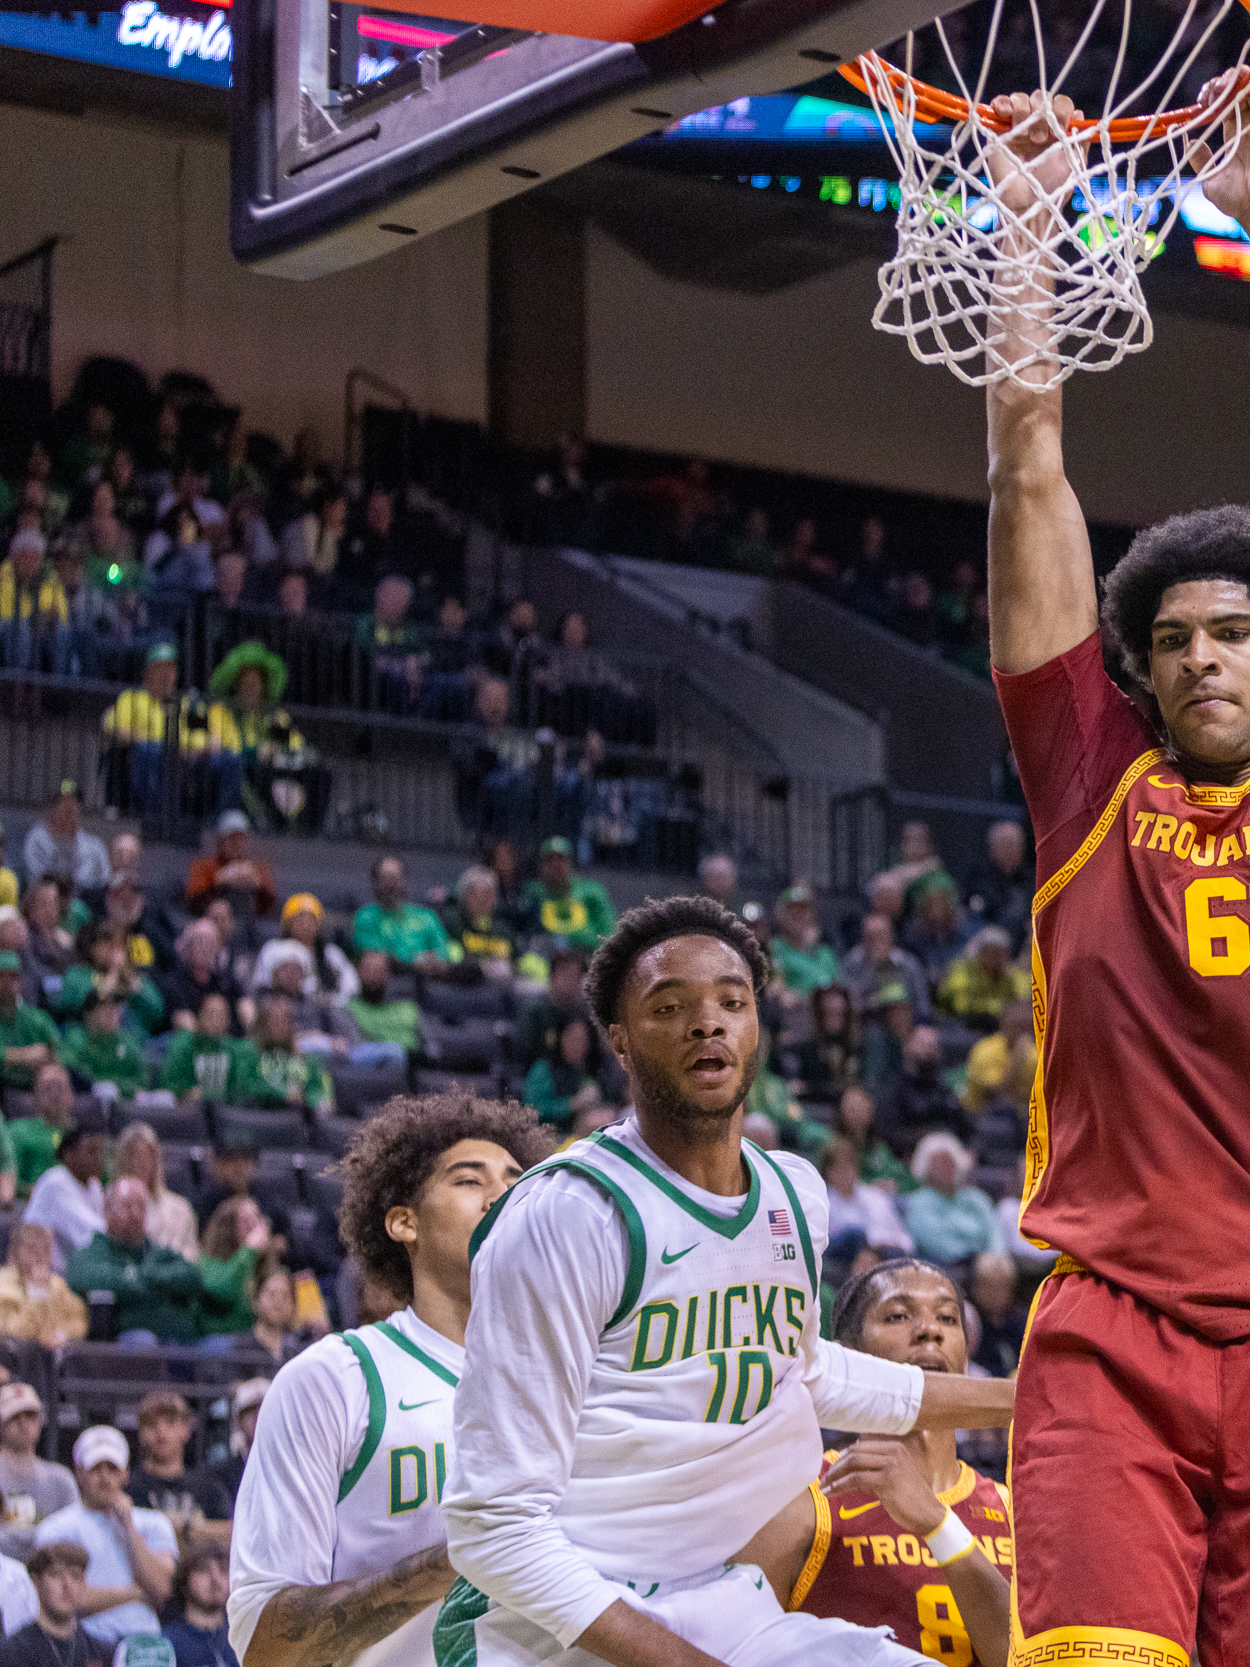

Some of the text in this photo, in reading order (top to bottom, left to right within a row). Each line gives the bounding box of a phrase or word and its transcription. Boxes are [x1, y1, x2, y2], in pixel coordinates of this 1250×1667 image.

[117, 0, 233, 68] Emplo
[630, 1284, 806, 1372] DUCKS
[703, 1350, 775, 1426] 10
[916, 1584, 973, 1667] 8
